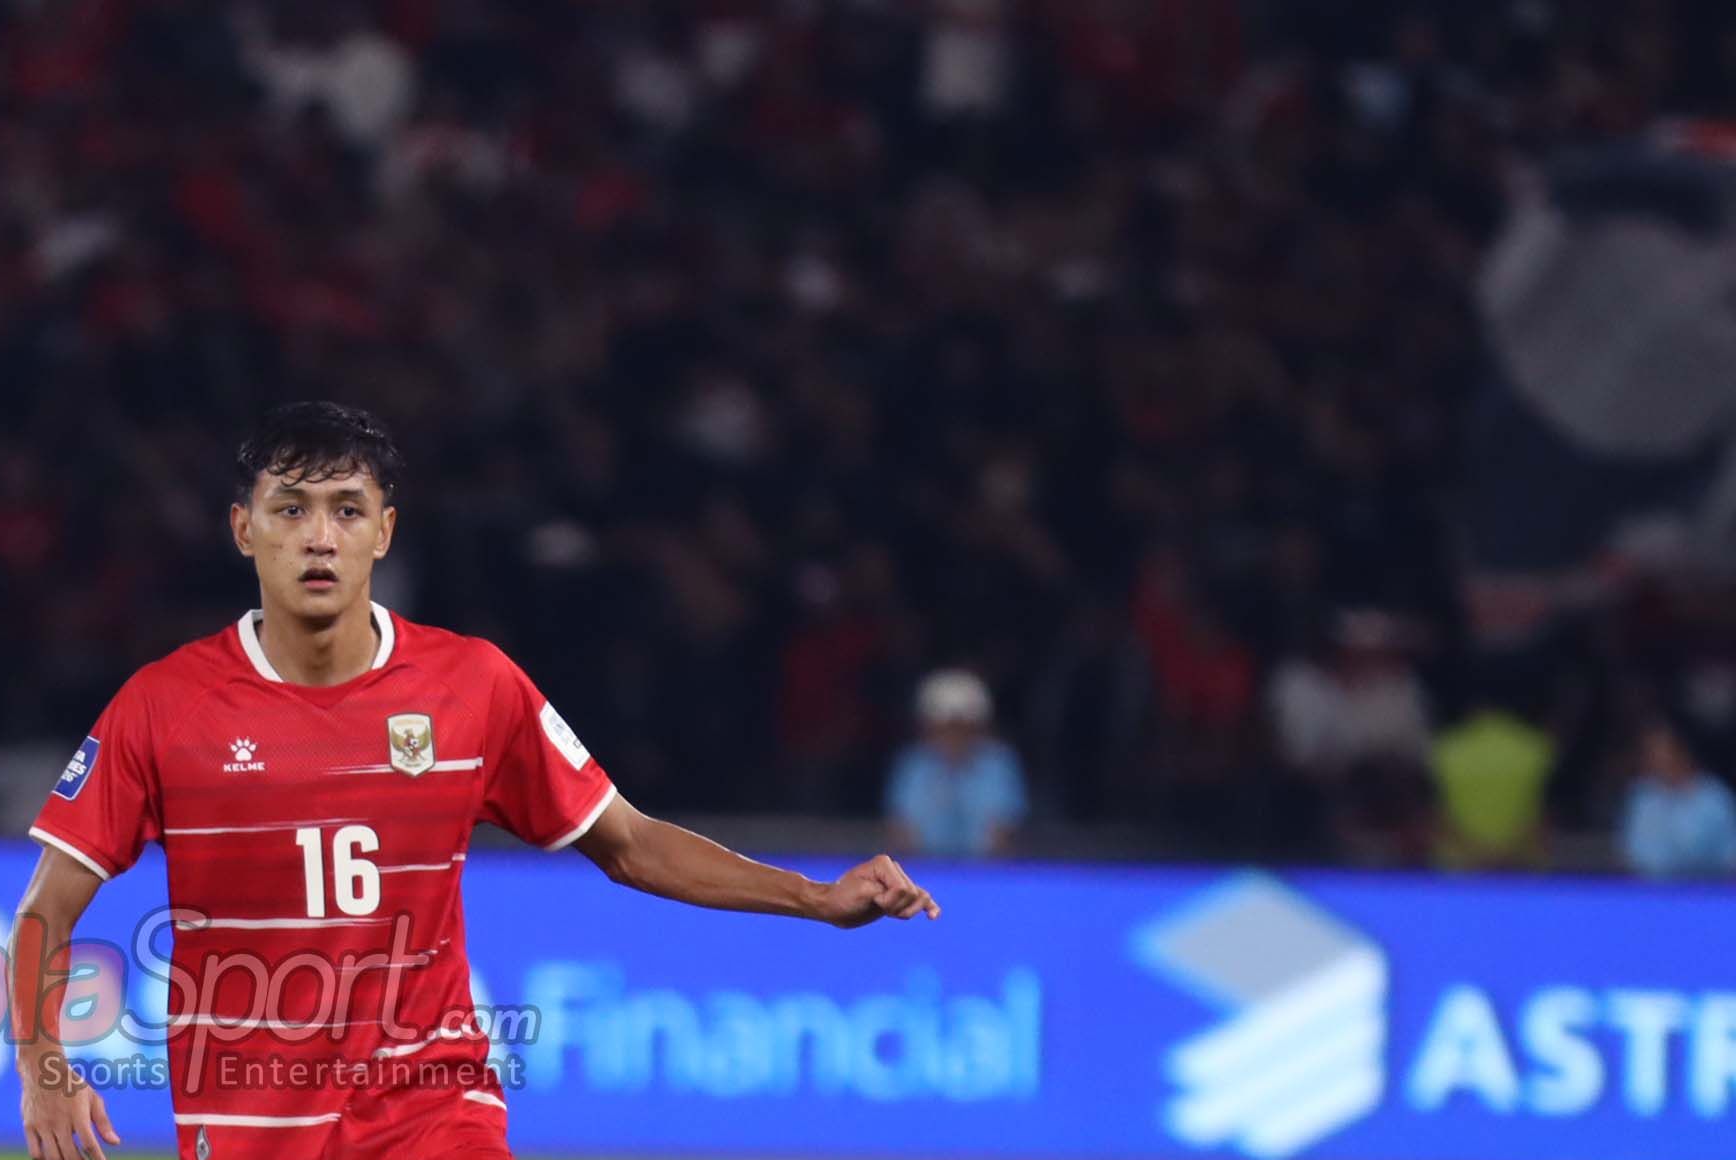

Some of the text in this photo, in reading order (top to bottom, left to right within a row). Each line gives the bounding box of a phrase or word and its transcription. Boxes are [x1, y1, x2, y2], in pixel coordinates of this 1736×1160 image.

[223, 762, 265, 772] KELME
[296, 825, 381, 917] 16
[524, 960, 1042, 1102] Financial
